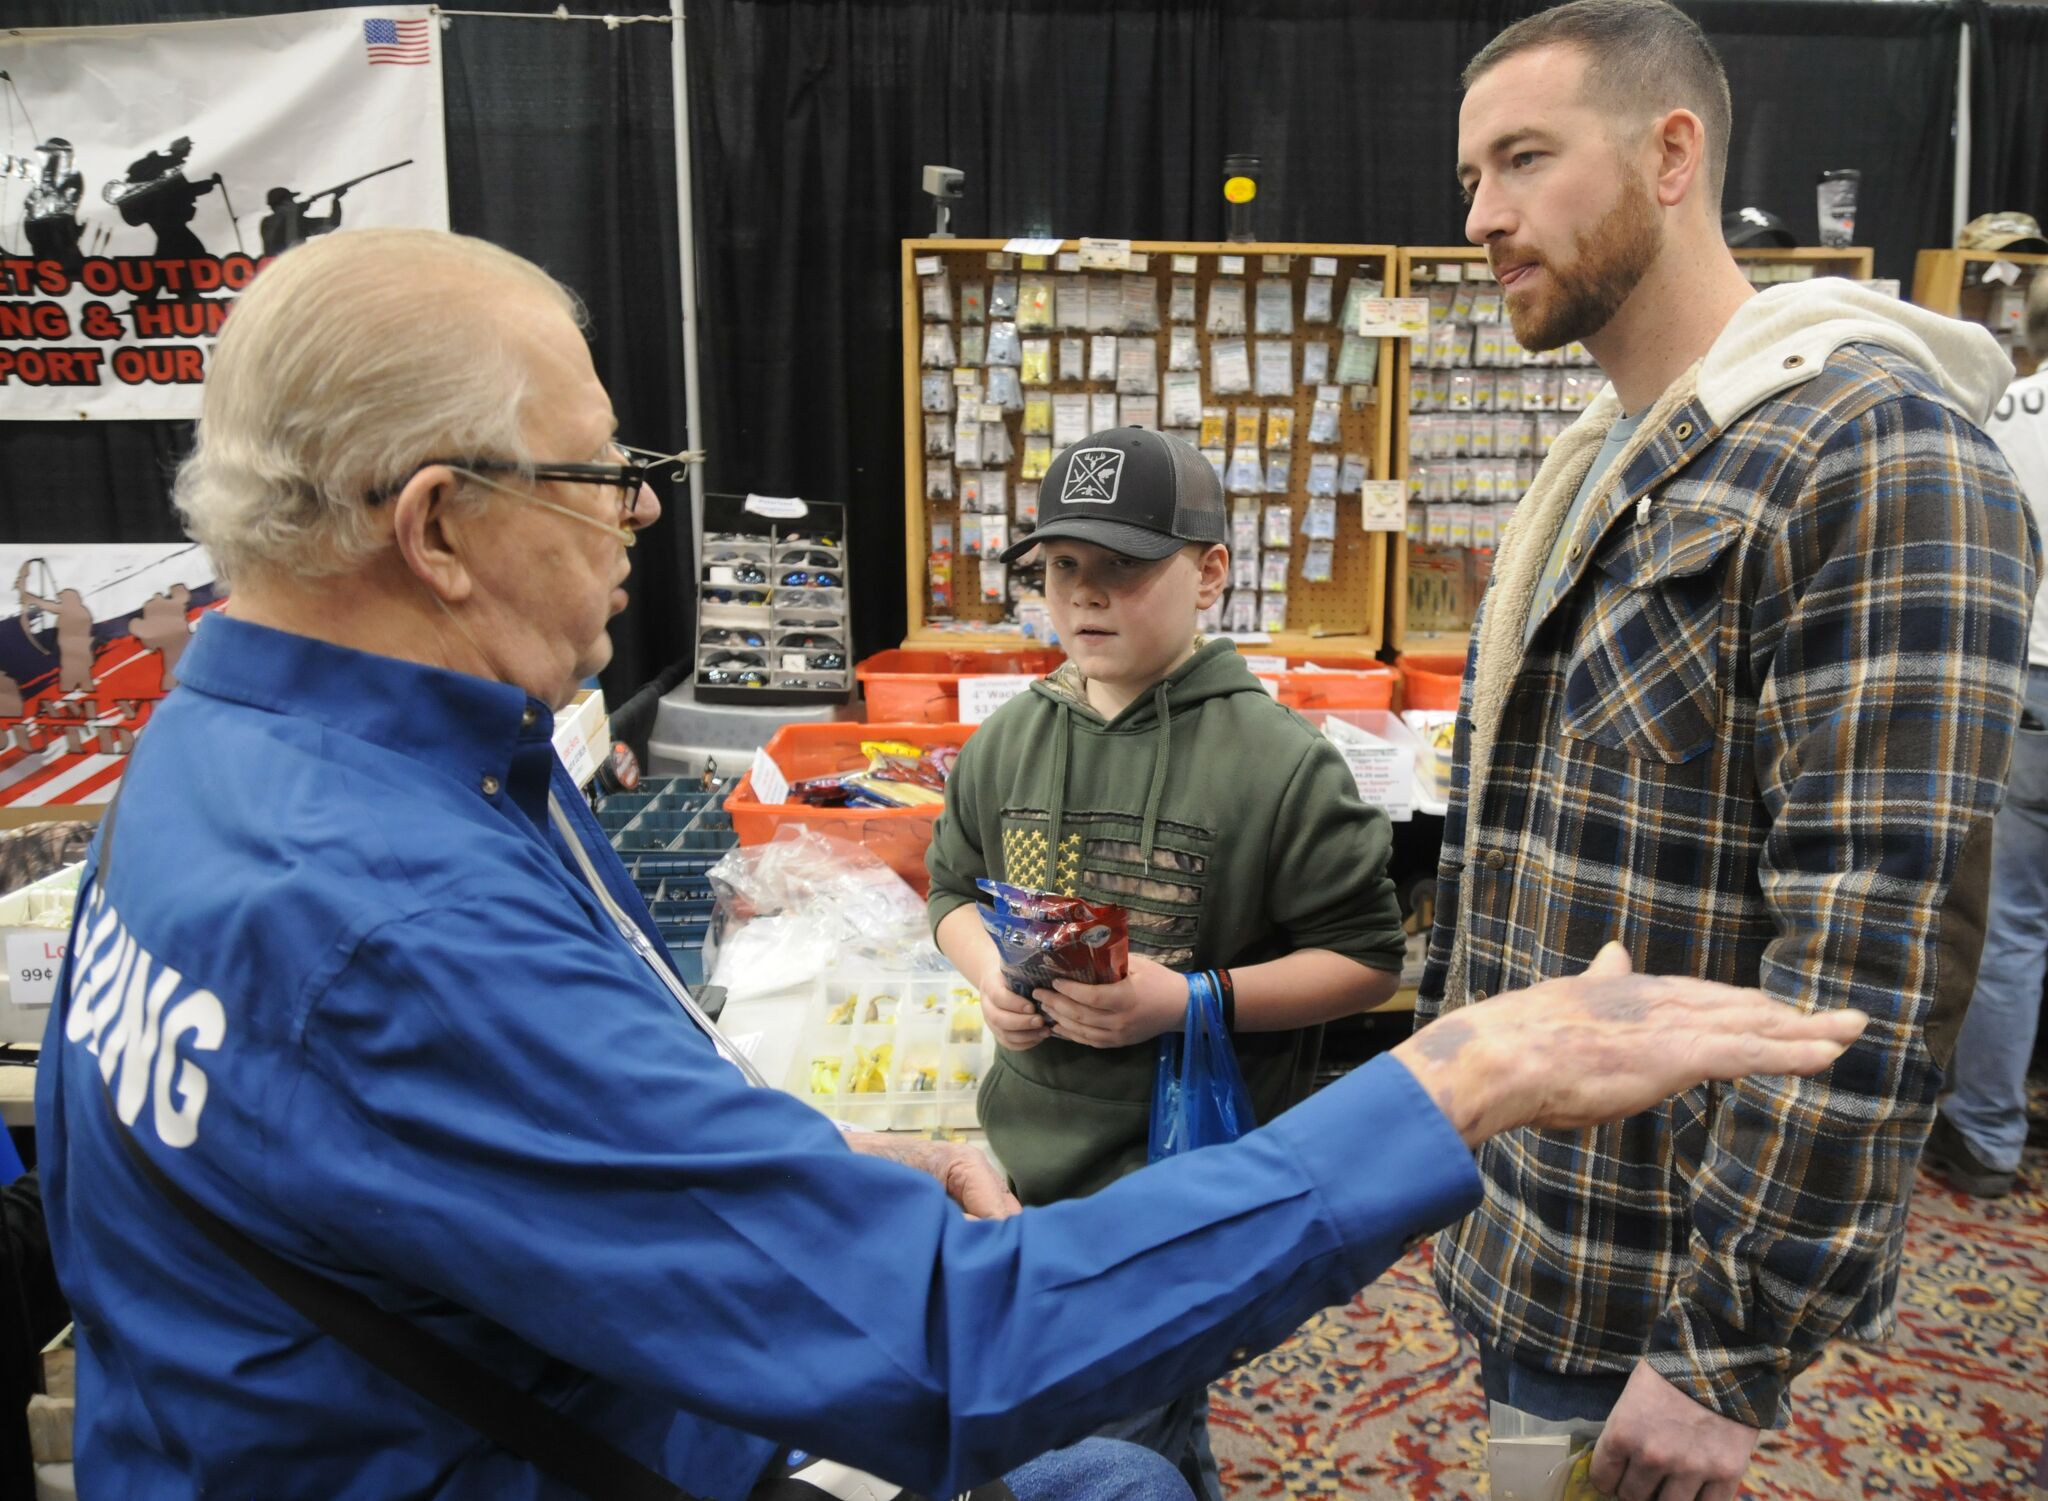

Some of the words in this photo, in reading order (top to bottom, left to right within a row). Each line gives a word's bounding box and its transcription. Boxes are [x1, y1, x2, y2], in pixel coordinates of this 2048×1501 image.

[0, 257, 69, 295] TS
[82, 302, 126, 340] &
[113, 347, 204, 384] OUR
[21, 967, 53, 982] 99¢
